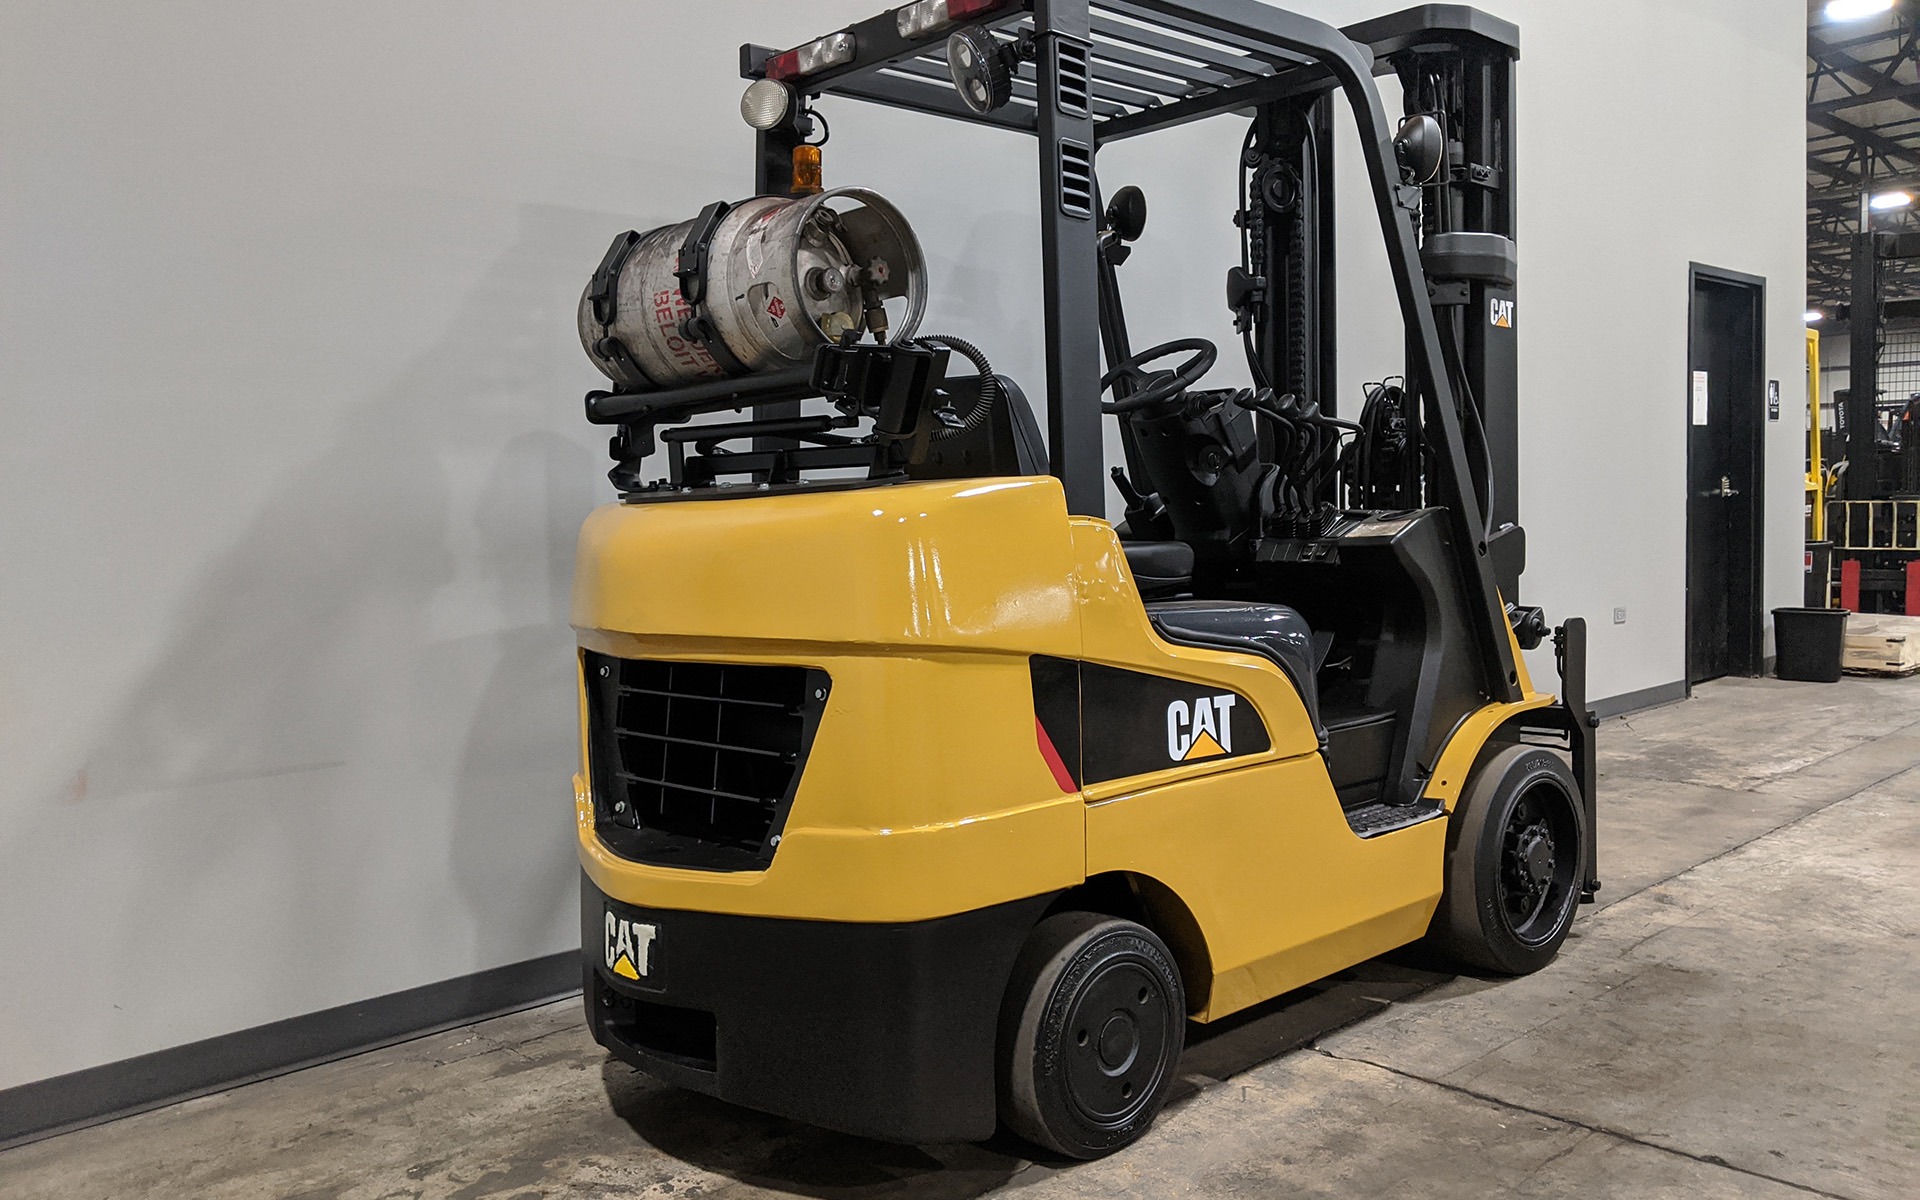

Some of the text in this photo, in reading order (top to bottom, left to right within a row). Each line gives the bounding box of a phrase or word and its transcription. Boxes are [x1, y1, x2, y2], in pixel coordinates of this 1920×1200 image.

[653, 290, 701, 368] BELOIT
[1490, 298, 1513, 328] CAT
[1167, 694, 1235, 761] CAT
[604, 911, 656, 977] CAT
